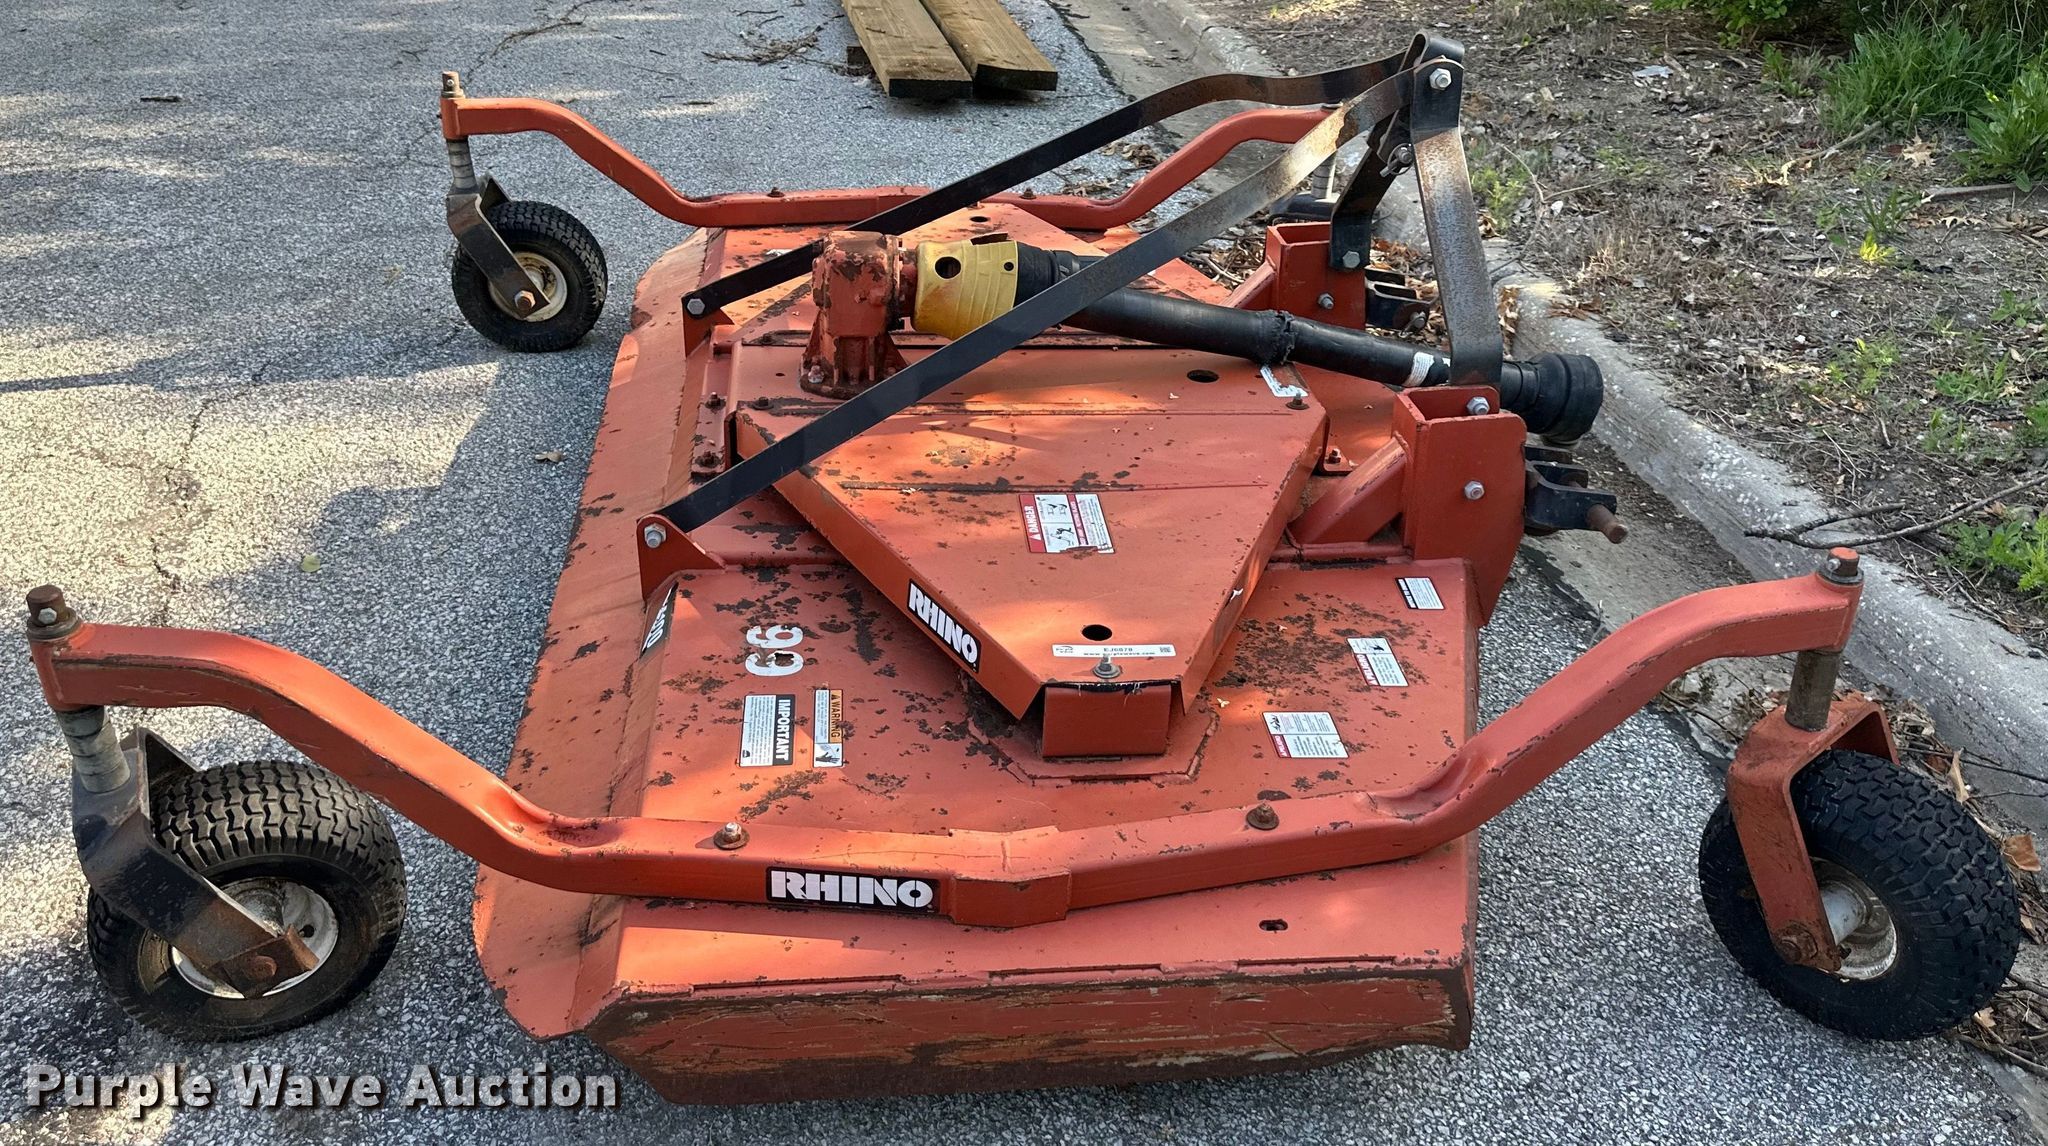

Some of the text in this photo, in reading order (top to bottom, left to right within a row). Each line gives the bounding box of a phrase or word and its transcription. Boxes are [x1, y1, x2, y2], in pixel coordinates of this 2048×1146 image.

[1024, 505, 1039, 533] DANGER
[908, 582, 978, 664] RHINO
[775, 699, 791, 761] IMPORTANT
[831, 701, 841, 738] WARNING
[770, 870, 933, 908] RHINO
